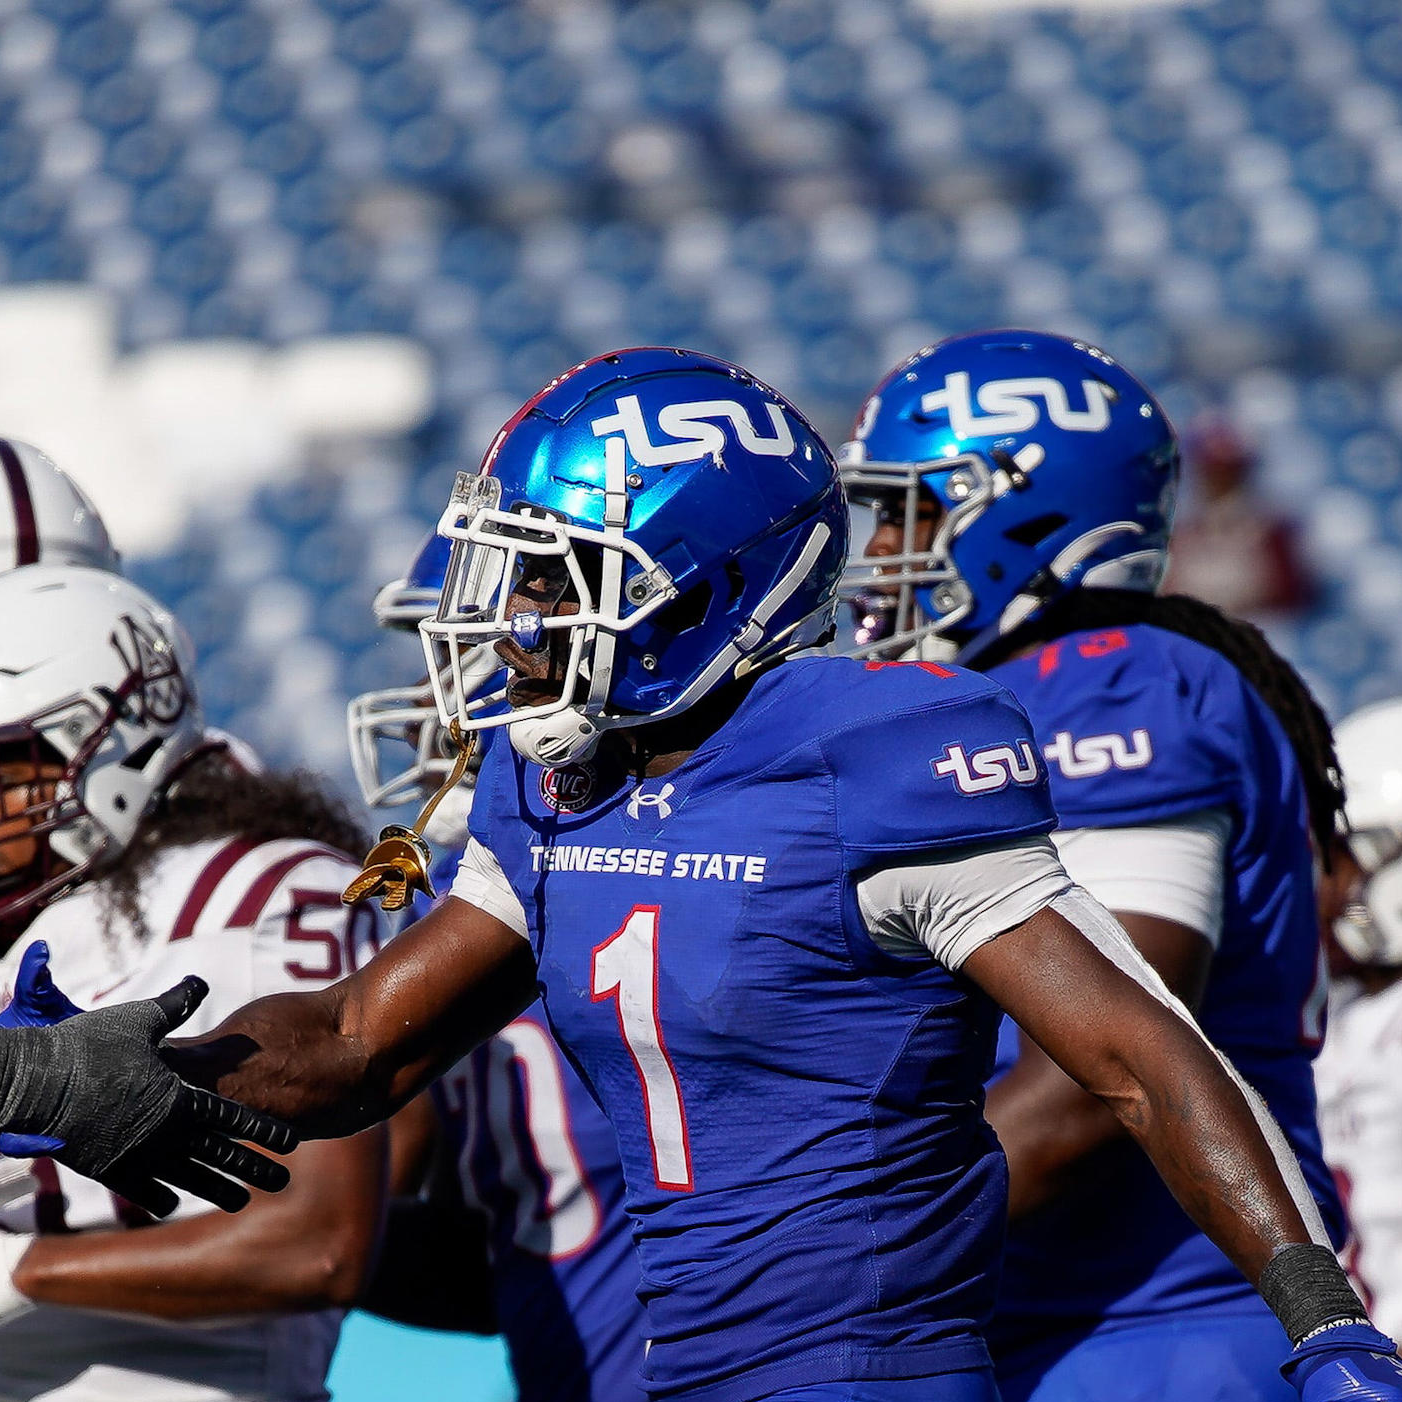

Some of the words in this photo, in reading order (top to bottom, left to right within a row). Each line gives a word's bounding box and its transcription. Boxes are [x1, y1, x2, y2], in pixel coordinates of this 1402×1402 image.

[529, 845, 665, 877] TENNESSEE
[671, 852, 767, 883] STATE
[590, 903, 695, 1192] 1
